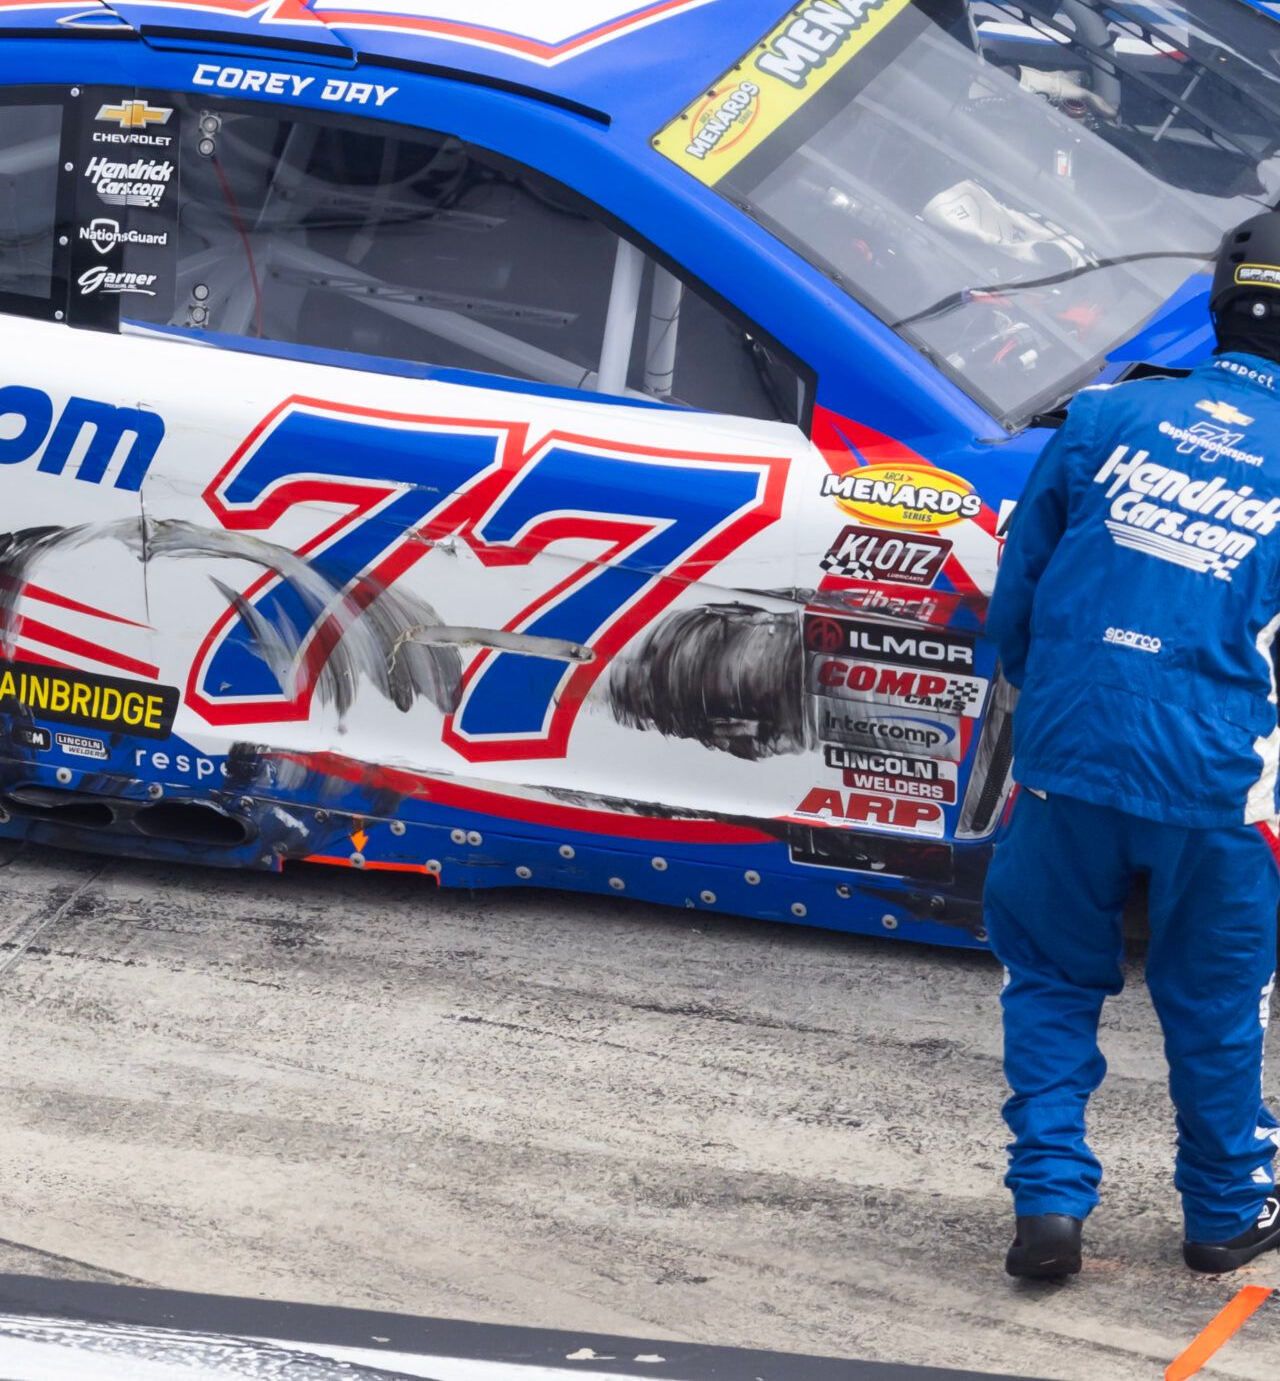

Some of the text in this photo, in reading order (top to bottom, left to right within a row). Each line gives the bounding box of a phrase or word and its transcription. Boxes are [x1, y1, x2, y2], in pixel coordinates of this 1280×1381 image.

[191, 63, 399, 108] COREY DAY
[685, 80, 761, 160] MENARDS
[92, 131, 172, 147] CHEVROLET
[84, 156, 175, 183] Hendrick
[96, 178, 165, 198] Cars.com
[78, 226, 168, 246] NationsGuard
[77, 264, 157, 296] Garner
[1213, 359, 1276, 391] respect.
[1158, 421, 1265, 468] @spiremotorsport
[883, 471, 905, 482] ARCA
[820, 473, 983, 519] MENARDS
[902, 510, 933, 523] SERIES
[1110, 491, 1257, 561] Cars.com
[836, 532, 943, 577] KLOTZ
[184, 392, 794, 764] 77
[849, 629, 974, 665] ILMOR
[1102, 625, 1162, 655] sparco
[816, 659, 948, 698] COMP
[903, 692, 967, 712] CAMS
[58, 735, 102, 750] LINCOLN
[824, 711, 941, 749] Intercomp
[67, 745, 108, 759] WELDERS
[829, 748, 934, 780] LINCOLN
[853, 772, 945, 800] WELDERS
[795, 786, 943, 829] ARP
